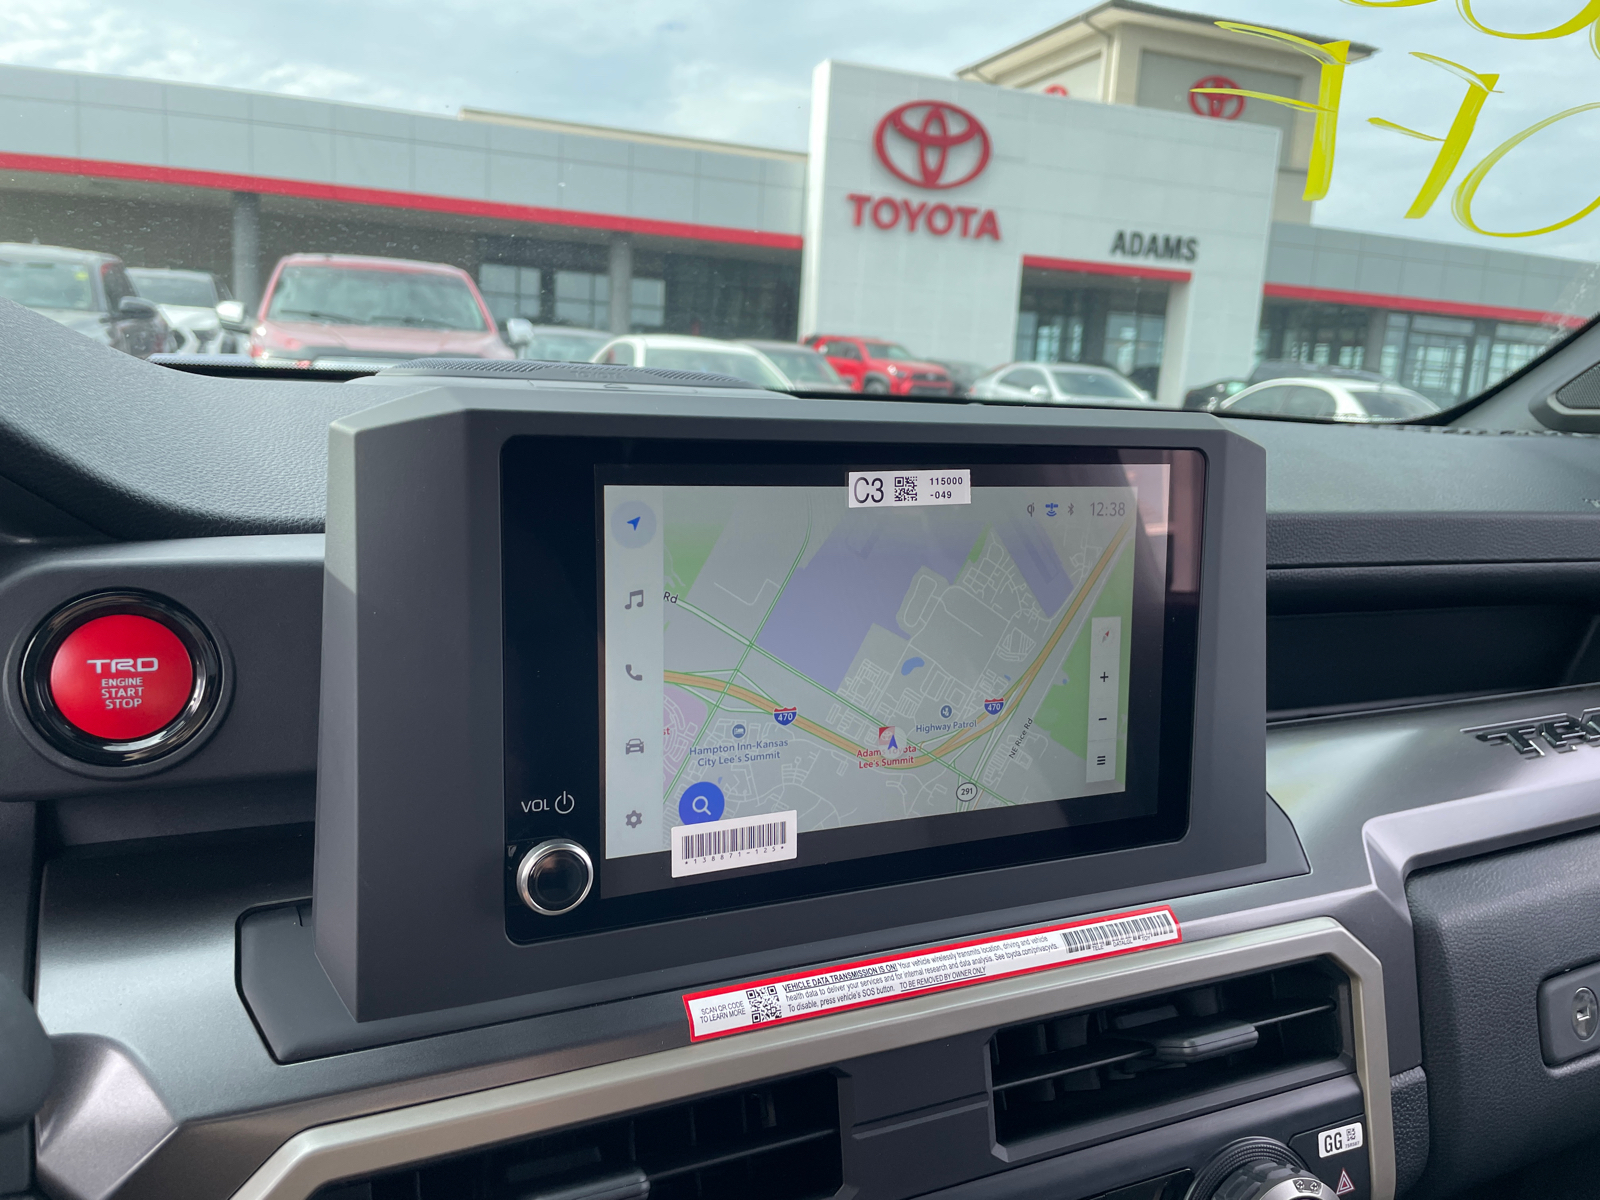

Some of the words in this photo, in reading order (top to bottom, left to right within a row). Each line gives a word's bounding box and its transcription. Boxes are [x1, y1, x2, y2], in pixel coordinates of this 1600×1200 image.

[847, 194, 1002, 241] TOYOTA
[1109, 230, 1198, 262] ADAMS
[570, 370, 627, 381] TOYOTA
[930, 477, 963, 485] 115000
[854, 477, 884, 503] C3
[930, 491, 952, 499] -049
[1090, 502, 1125, 516] 12:38
[663, 591, 678, 604] Rd
[87, 657, 158, 673] TRD
[102, 677, 143, 686] ENGINE
[102, 687, 144, 698] START
[106, 698, 142, 709] STOP
[987, 703, 1000, 711] 470
[778, 712, 793, 721] 470
[916, 723, 951, 734] Highway
[953, 720, 977, 729] Patrol
[1008, 747, 1018, 759] NE
[1015, 731, 1027, 747] Rice
[1024, 718, 1033, 730] Rd
[690, 745, 735, 756] Hampton
[737, 740, 788, 751] Inn-Kansas
[857, 749, 886, 758] Adams
[698, 758, 716, 767] City
[719, 755, 742, 765] Lee's
[744, 751, 780, 762] Summit
[859, 760, 880, 769] Lee's
[881, 756, 914, 767] Summit
[961, 787, 973, 796] 291
[521, 798, 550, 813] VOL
[781, 980, 809, 991] VEHICLE
[812, 976, 829, 985] DATA
[830, 967, 877, 981] TRANSMISSION
[887, 962, 897, 971] ON!
[897, 960, 910, 968] Your
[911, 957, 930, 966] vehicle
[931, 952, 956, 963] wirelessly
[957, 948, 979, 957] transmits
[980, 943, 1002, 953] location,
[1003, 939, 1020, 950] driving
[1032, 935, 1047, 944] vehicle
[786, 991, 803, 1001] health
[805, 989, 817, 997] data
[826, 984, 844, 992] deliver
[847, 982, 858, 991] your
[860, 977, 882, 986] services
[884, 973, 894, 981] and
[904, 969, 924, 977] internal
[924, 964, 947, 973] research
[948, 961, 957, 969] and
[959, 959, 970, 967] data
[972, 955, 993, 965] analysis.
[995, 952, 1004, 960] See
[916, 975, 942, 984] REMOVED
[952, 969, 972, 977] OWNER
[973, 966, 985, 974] ONLY
[796, 999, 818, 1009] disable,
[820, 996, 835, 1006] press
[836, 991, 860, 1001] vehicle's
[862, 988, 874, 996] SOS
[876, 984, 894, 993] button.
[701, 1006, 716, 1014] SCAN
[727, 1000, 743, 1009] CODE
[709, 1012, 728, 1020] LEARN
[729, 1008, 745, 1016] MORE
[1325, 1132, 1343, 1153] GG
